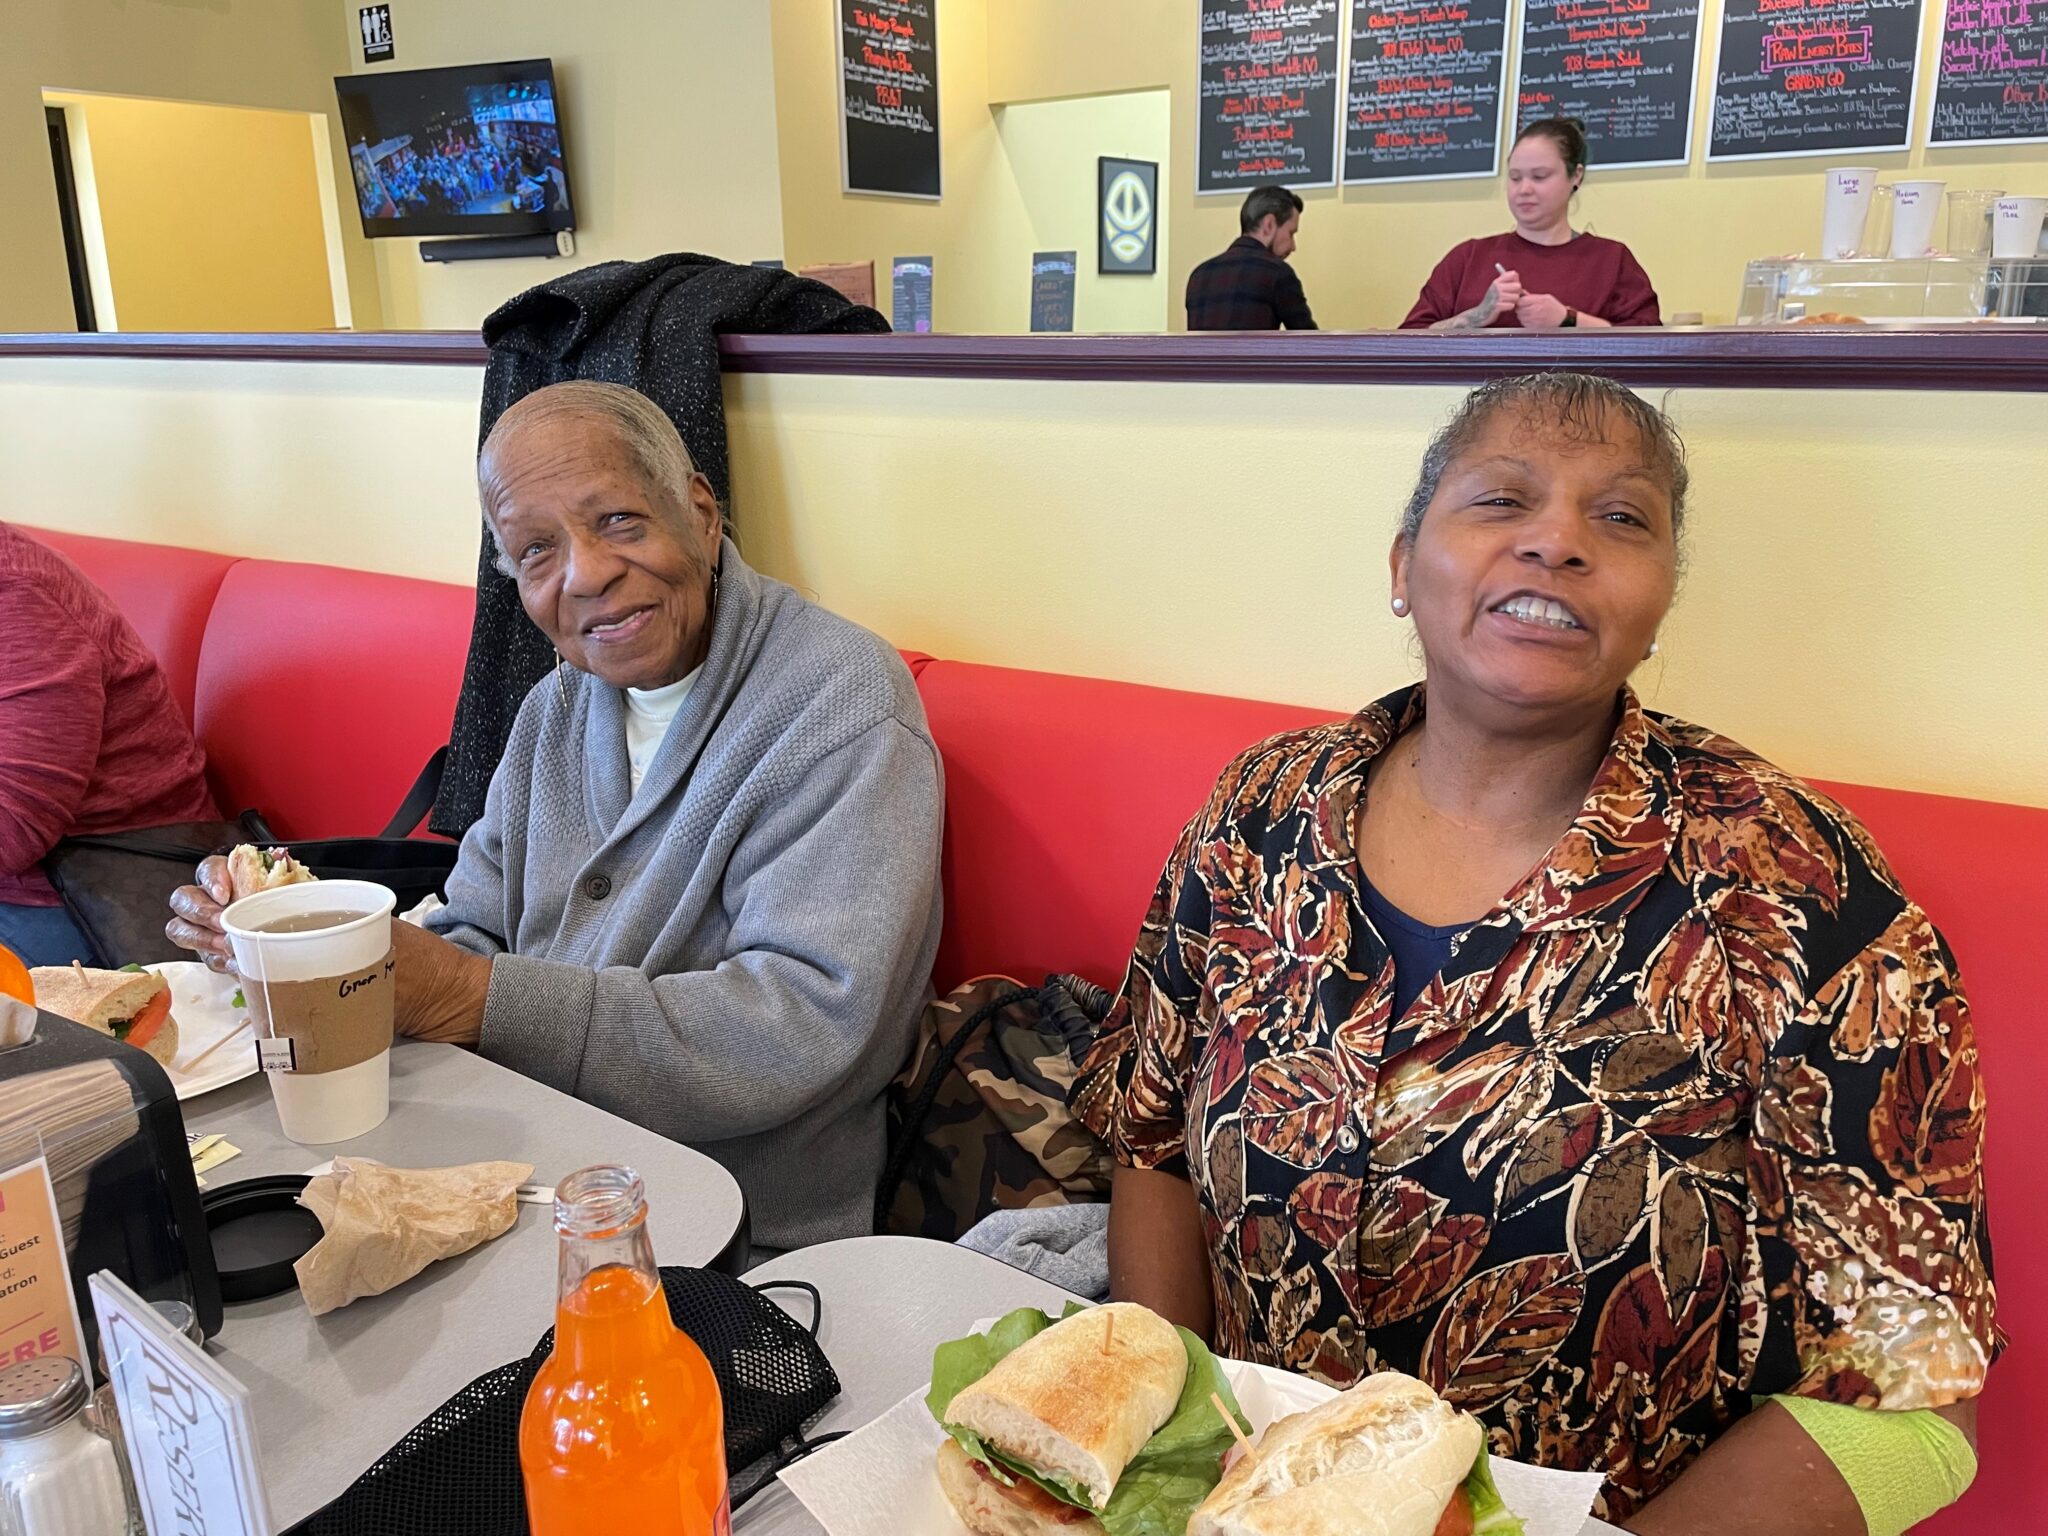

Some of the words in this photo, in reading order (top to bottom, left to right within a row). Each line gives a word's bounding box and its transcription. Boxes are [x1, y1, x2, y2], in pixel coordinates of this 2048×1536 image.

[1770, 41, 1796, 63] RAW
[1838, 174, 1860, 188] Large
[1895, 189, 1920, 199] Medium
[1998, 202, 2019, 211] Small
[0, 1235, 40, 1260] Guest
[142, 1341, 207, 1536] RESER
